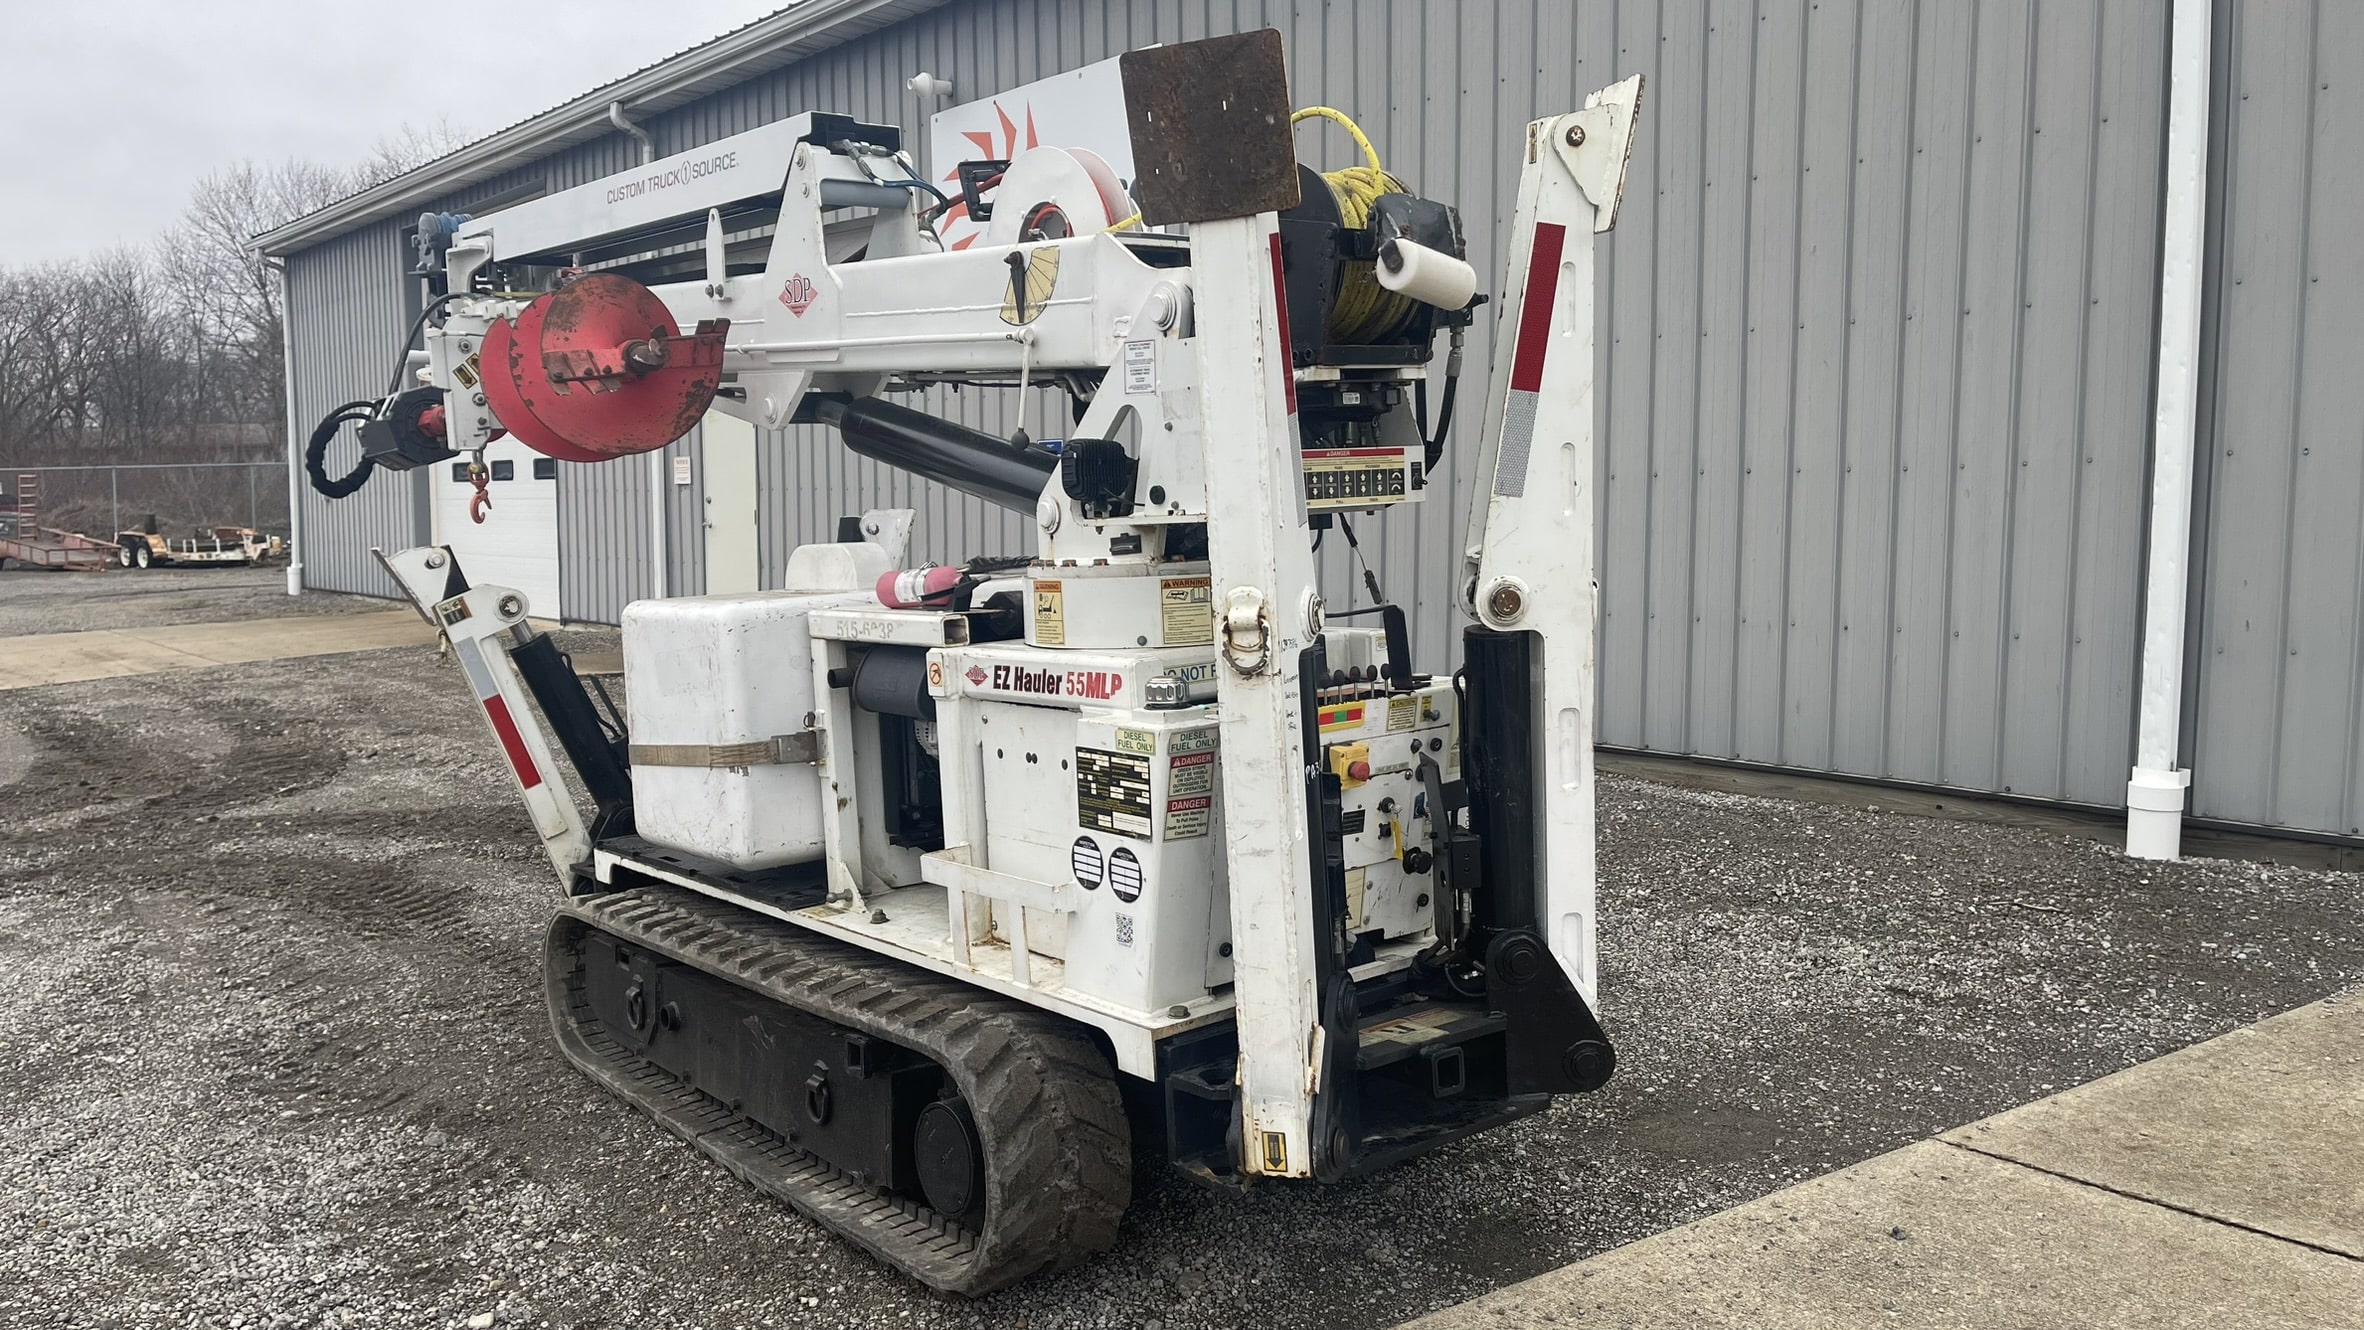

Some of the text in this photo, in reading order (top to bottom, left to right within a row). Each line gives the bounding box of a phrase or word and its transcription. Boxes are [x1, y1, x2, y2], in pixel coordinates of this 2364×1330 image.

[606, 180, 645, 204] CUSTOM
[648, 169, 680, 192] TRUCK
[692, 152, 736, 179] SOURCE
[784, 277, 811, 304] SDP
[1172, 579, 1209, 587] WARNING
[1181, 665, 1207, 681] NOT
[993, 665, 1123, 699] EZ Hauler 55MLP
[1123, 731, 1146, 742] DIESEL
[1180, 731, 1208, 742] DIESEL
[1117, 739, 1153, 752] FUEL ONLY
[1170, 738, 1217, 752] FUEL ONLY
[1181, 754, 1212, 766] DANGER
[1171, 798, 1206, 810] DANGER
